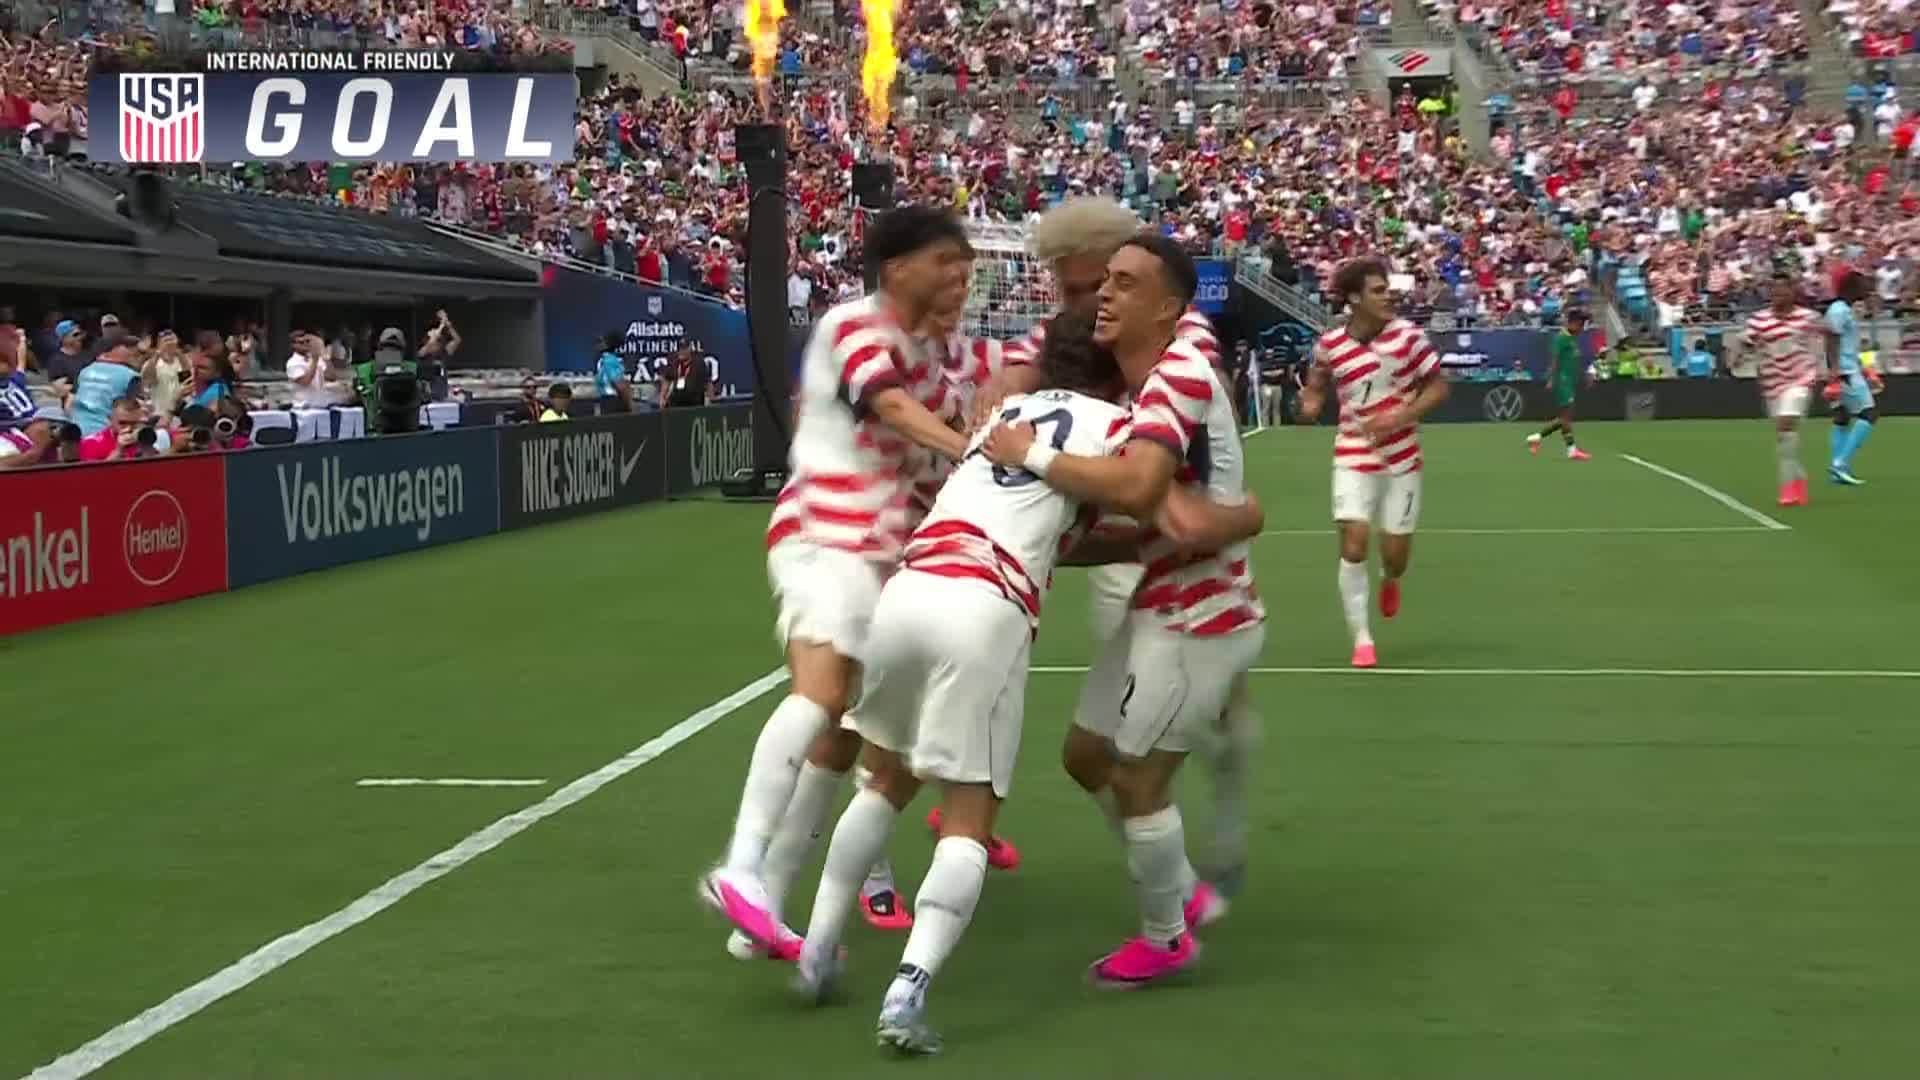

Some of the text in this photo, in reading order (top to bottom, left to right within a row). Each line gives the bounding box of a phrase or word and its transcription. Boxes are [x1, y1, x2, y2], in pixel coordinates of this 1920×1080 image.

[626, 321, 684, 337] Allstate
[277, 455, 464, 544] Volkswagen
[522, 432, 615, 513] NIKE SOCCER
[129, 516, 182, 555] Henkel
